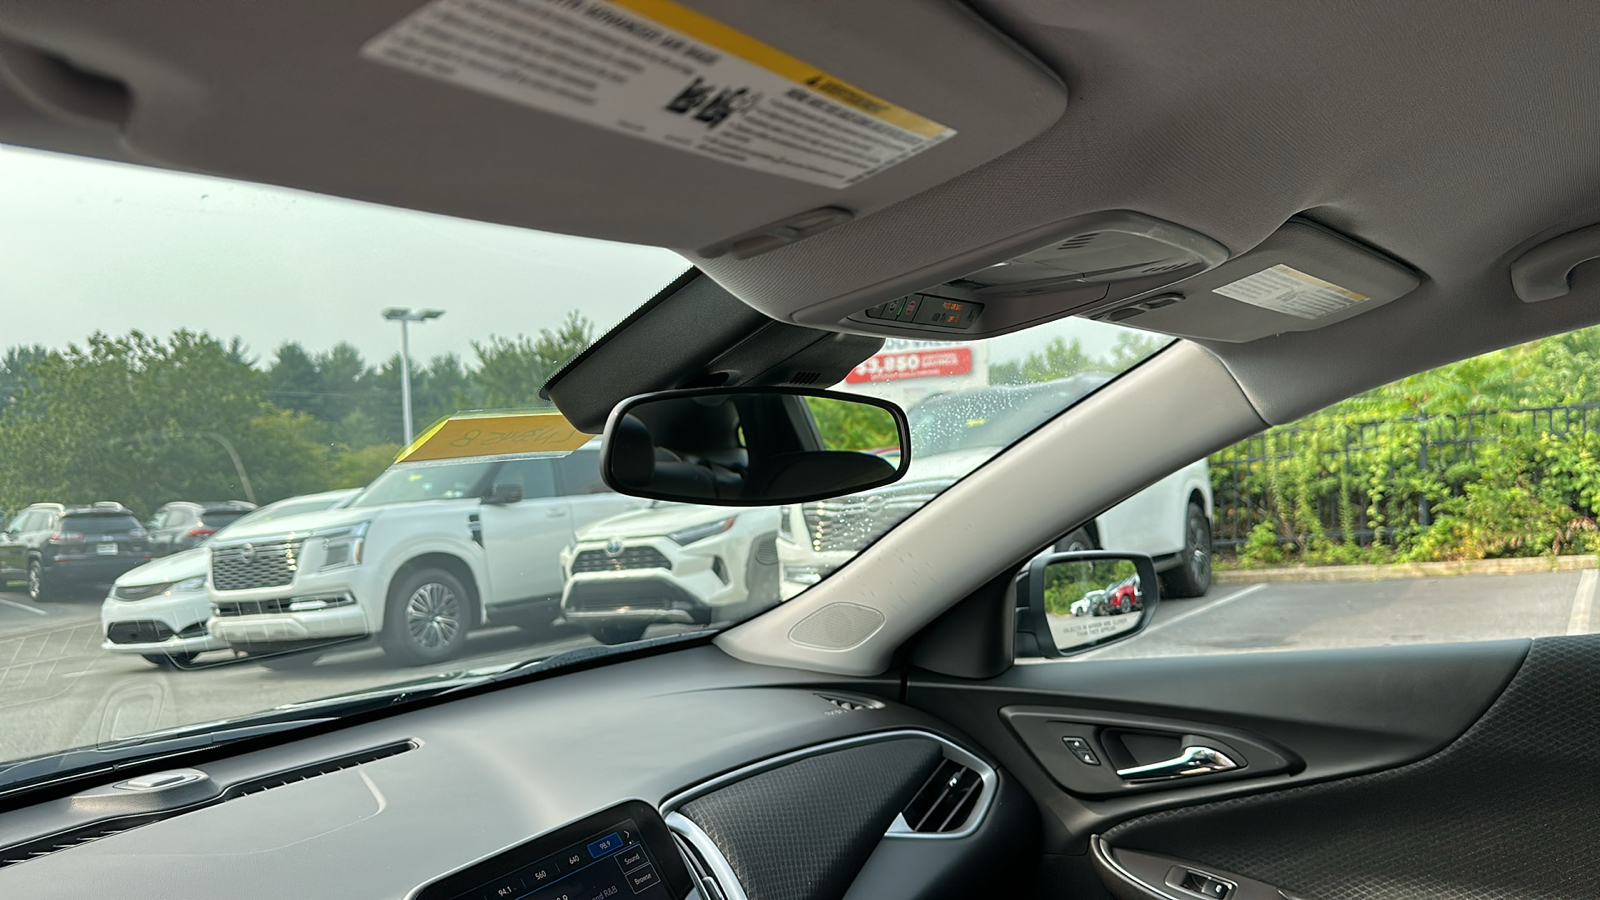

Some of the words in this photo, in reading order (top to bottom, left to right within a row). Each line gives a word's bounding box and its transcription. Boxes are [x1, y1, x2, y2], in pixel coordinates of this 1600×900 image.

[623, 853, 641, 866] Sound
[498, 886, 512, 897] 94.1
[534, 870, 547, 881] 560
[568, 855, 580, 865] 640
[599, 840, 611, 850] 98.9
[633, 872, 652, 885] Browse
[603, 885, 618, 898] R&B
